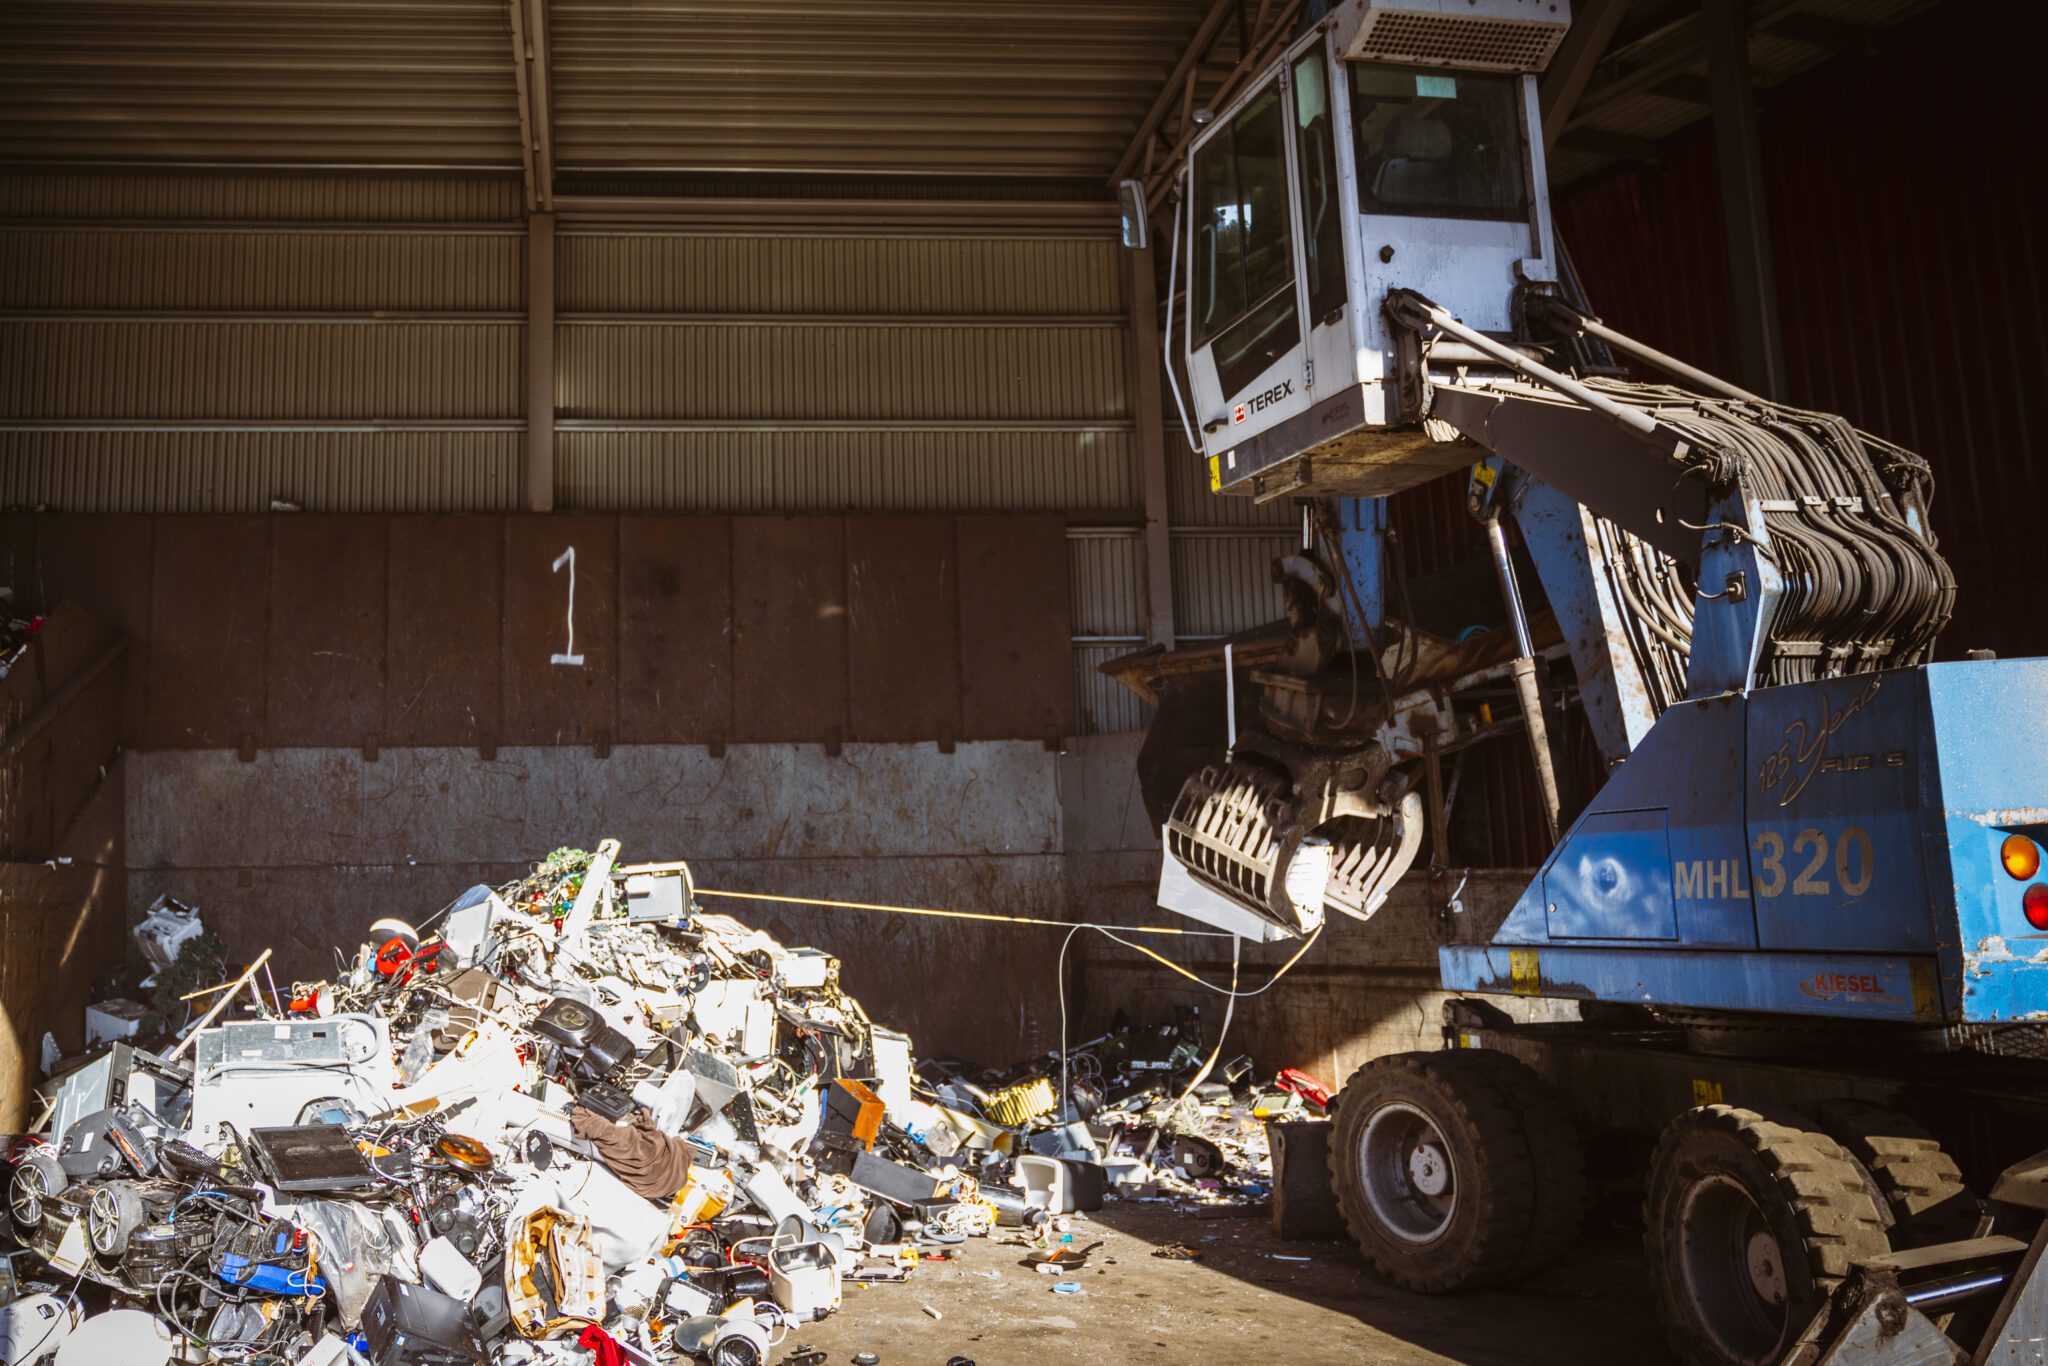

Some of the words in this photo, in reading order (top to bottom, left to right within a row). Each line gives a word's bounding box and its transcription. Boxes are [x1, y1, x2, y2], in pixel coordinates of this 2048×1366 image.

[1247, 379, 1293, 415] TEREX
[551, 546, 585, 665] 1
[1820, 751, 1905, 773] FUCS
[1814, 973, 1886, 994] KIESEL
